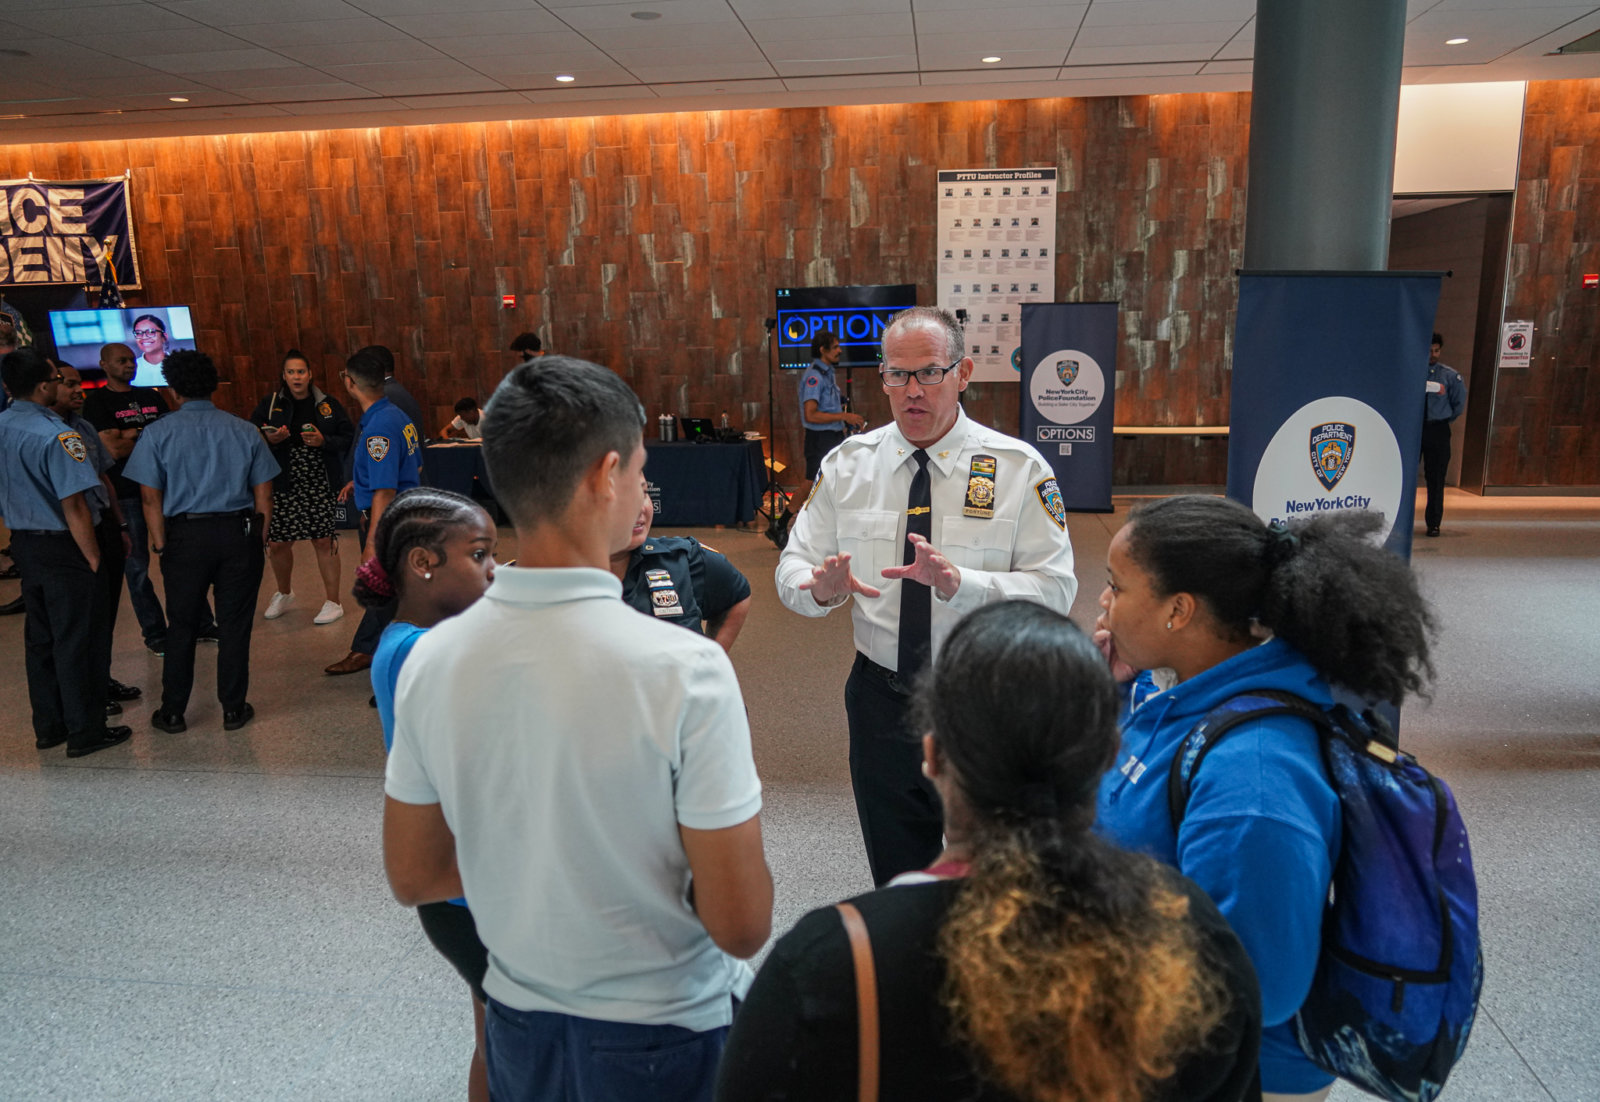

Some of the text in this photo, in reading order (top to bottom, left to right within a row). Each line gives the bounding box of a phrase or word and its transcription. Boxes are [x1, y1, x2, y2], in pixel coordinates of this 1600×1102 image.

[977, 172, 1013, 180] Instructor
[1014, 171, 1042, 179] Profiles
[783, 313, 893, 343] OPTION
[1040, 429, 1093, 440] OPTIONS
[1322, 424, 1345, 432] POLICE
[1312, 431, 1353, 444] DEPARTMENT
[1311, 451, 1324, 478] CITY OF
[1336, 447, 1352, 480] NEW YORK
[1286, 495, 1371, 513] New York City
